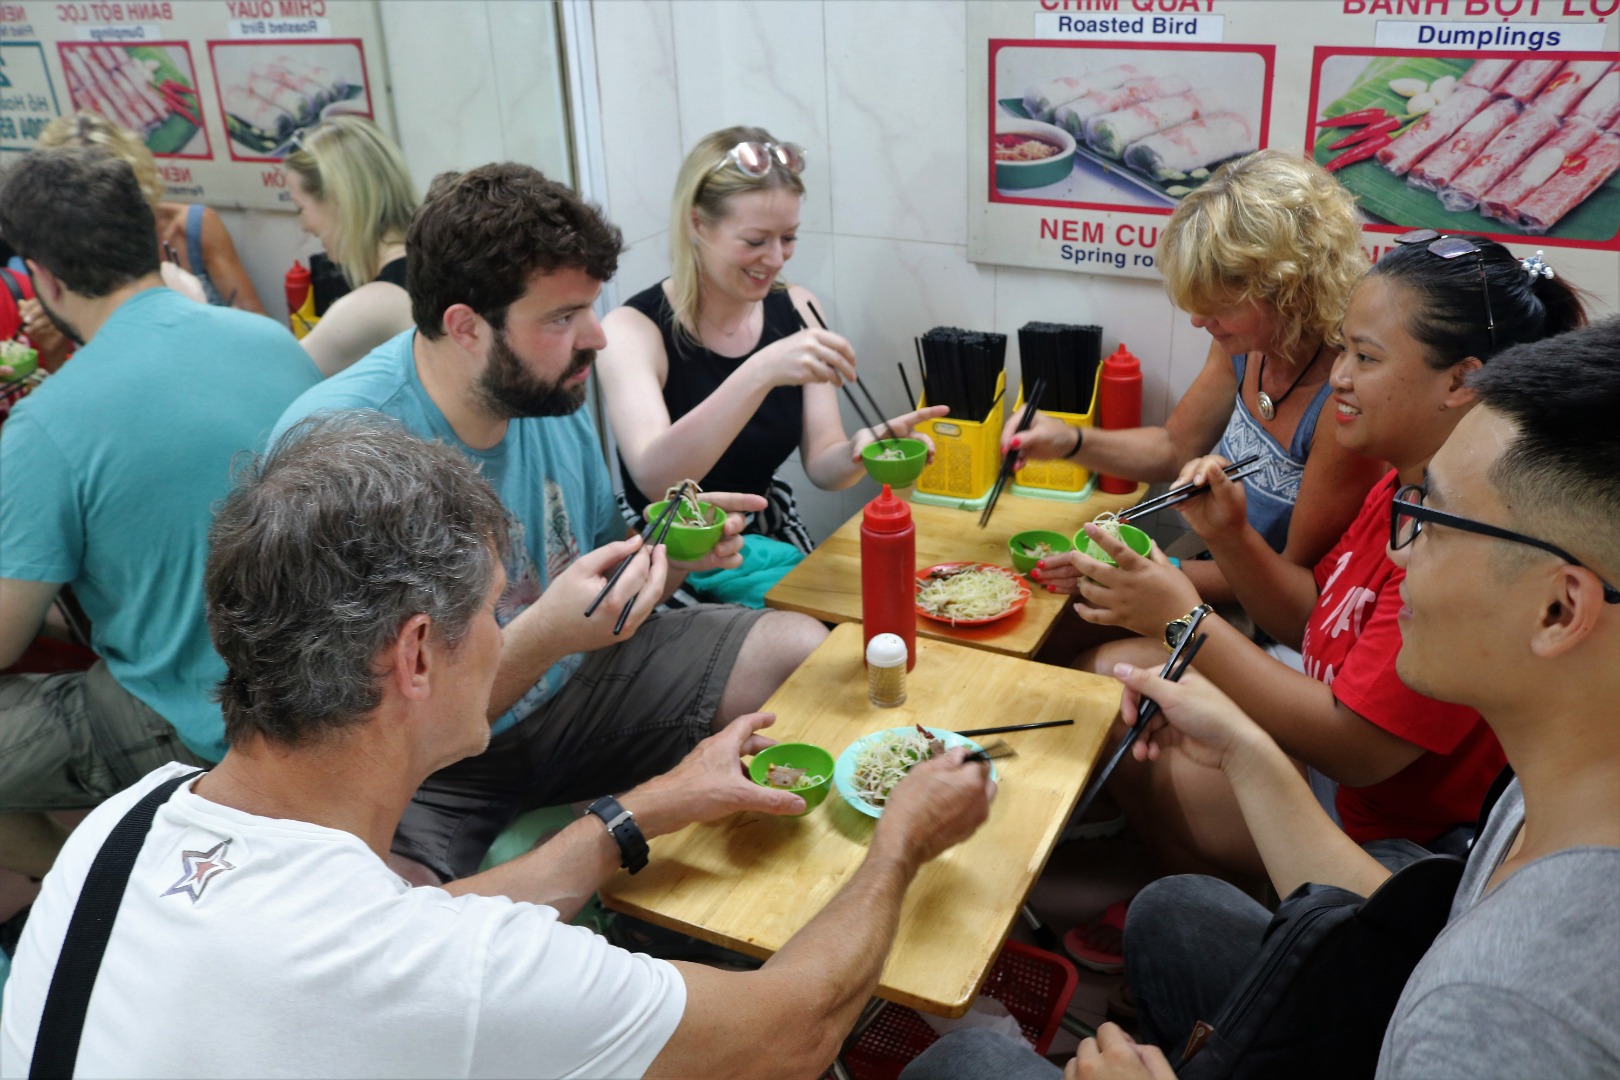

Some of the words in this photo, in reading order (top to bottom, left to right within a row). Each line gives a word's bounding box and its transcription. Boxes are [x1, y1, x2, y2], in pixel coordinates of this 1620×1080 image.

[1058, 16, 1144, 34] Roasted
[1152, 17, 1198, 35] Bird
[1417, 25, 1561, 51] Dumplings
[1040, 218, 1104, 244] NEM
[1115, 224, 1164, 249] CU
[1061, 244, 1126, 269] Spring
[1134, 253, 1158, 268] ro
